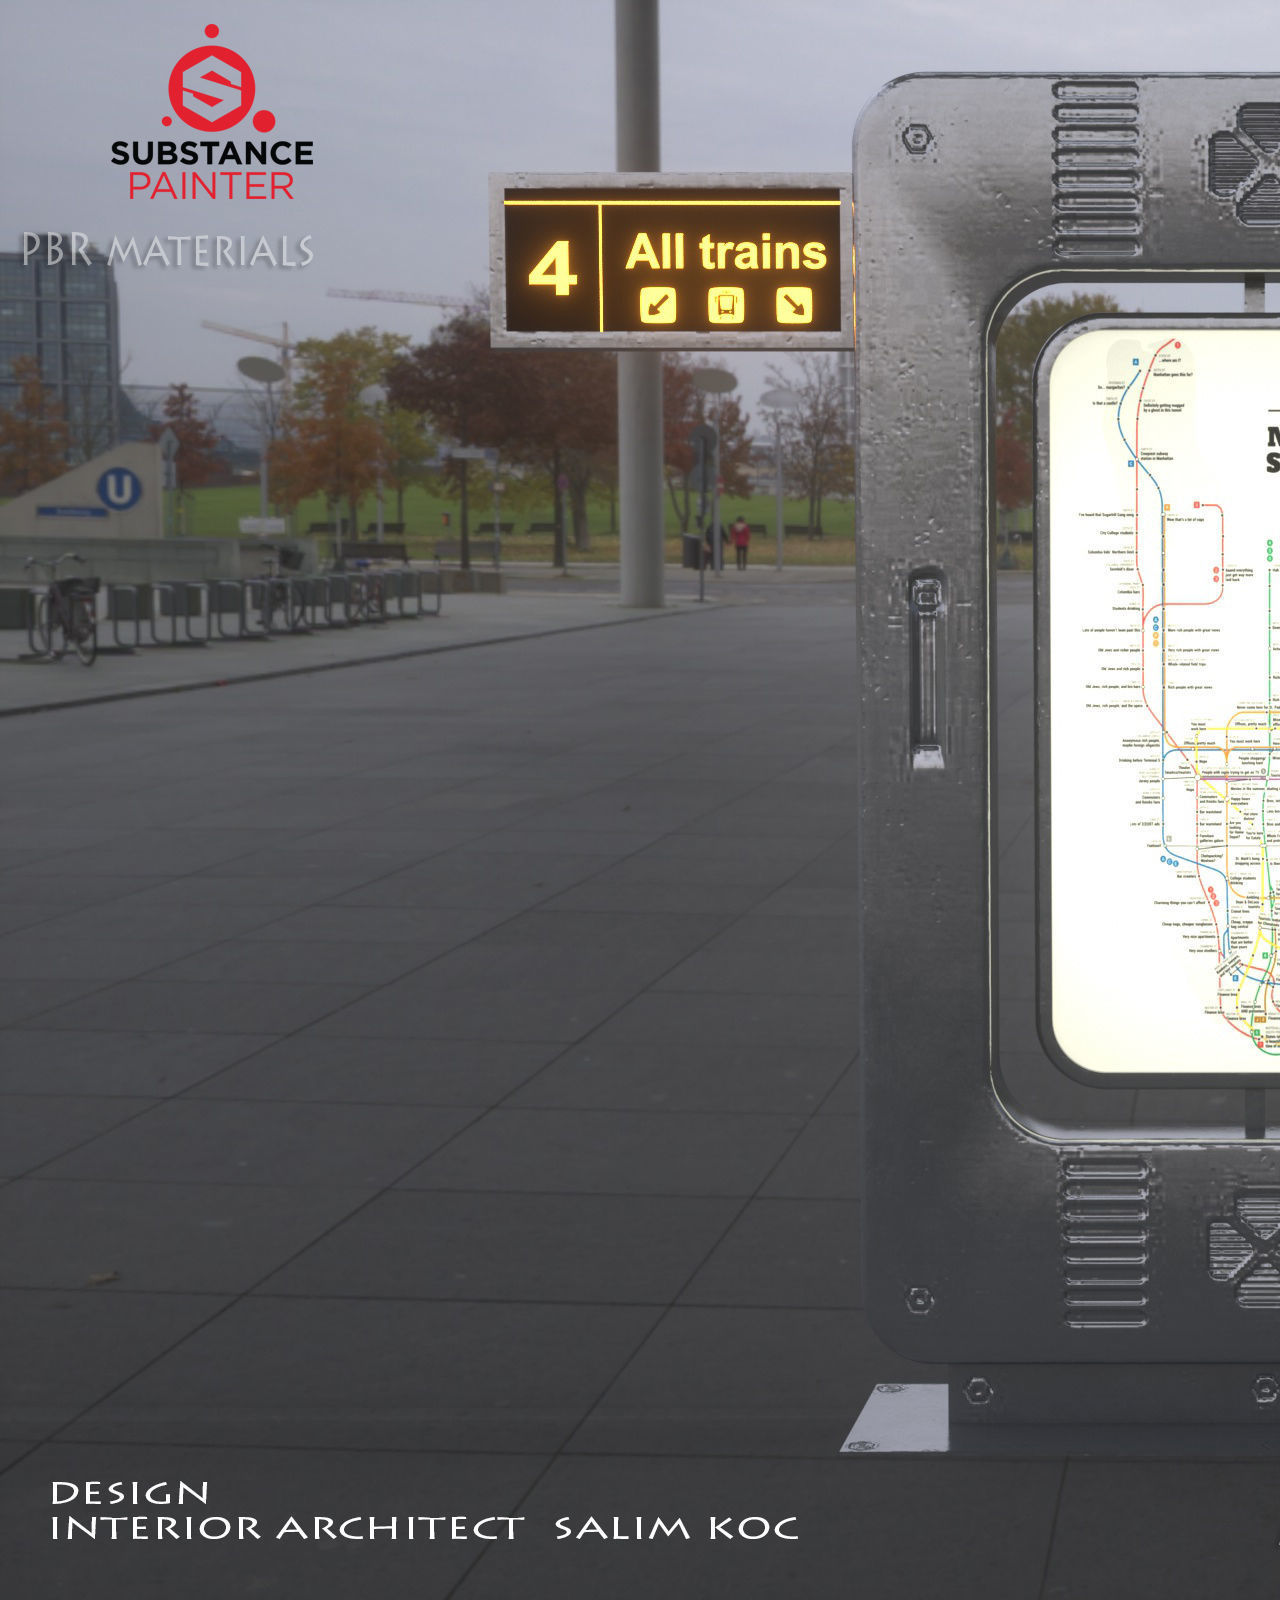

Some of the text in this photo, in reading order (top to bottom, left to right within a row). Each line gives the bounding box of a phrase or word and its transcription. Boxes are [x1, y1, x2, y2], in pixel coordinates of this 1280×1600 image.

[528, 240, 578, 296] 4
[625, 232, 828, 270] All trains
[107, 474, 132, 504] U
